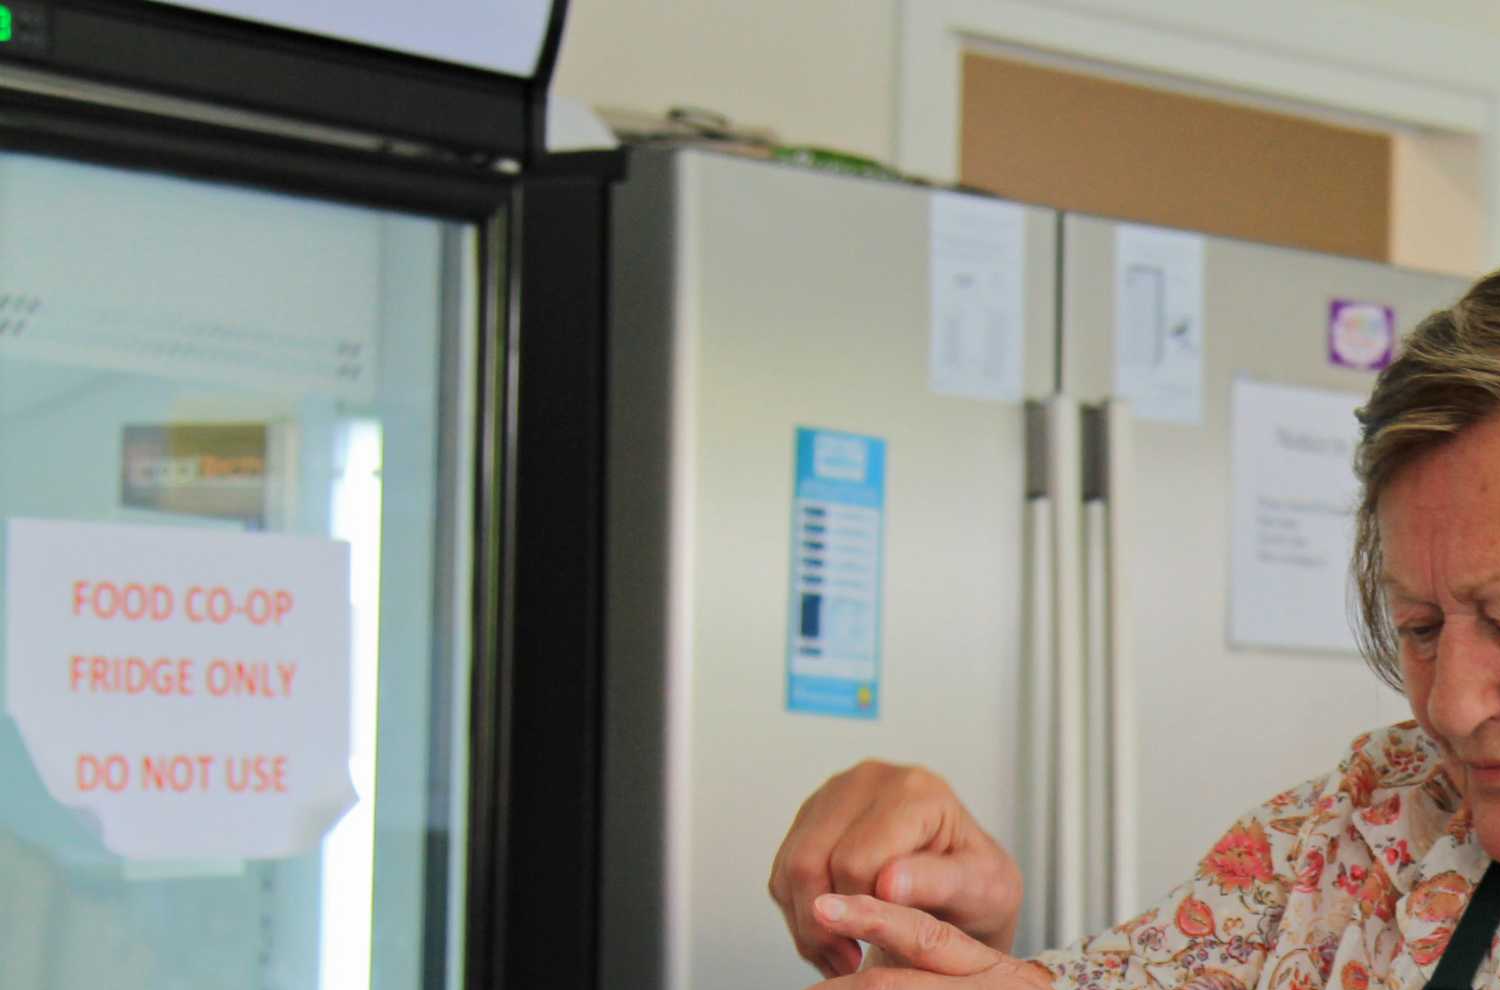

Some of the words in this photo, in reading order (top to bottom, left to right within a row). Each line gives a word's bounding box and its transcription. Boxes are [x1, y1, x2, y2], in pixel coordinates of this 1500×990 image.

[72, 580, 174, 621] FOOD
[184, 585, 294, 626] CO-OP
[69, 655, 193, 695] FRIDGE
[206, 658, 298, 698] ONLY
[76, 753, 129, 793] DO
[141, 755, 215, 793] NOT
[226, 755, 288, 793] USE
